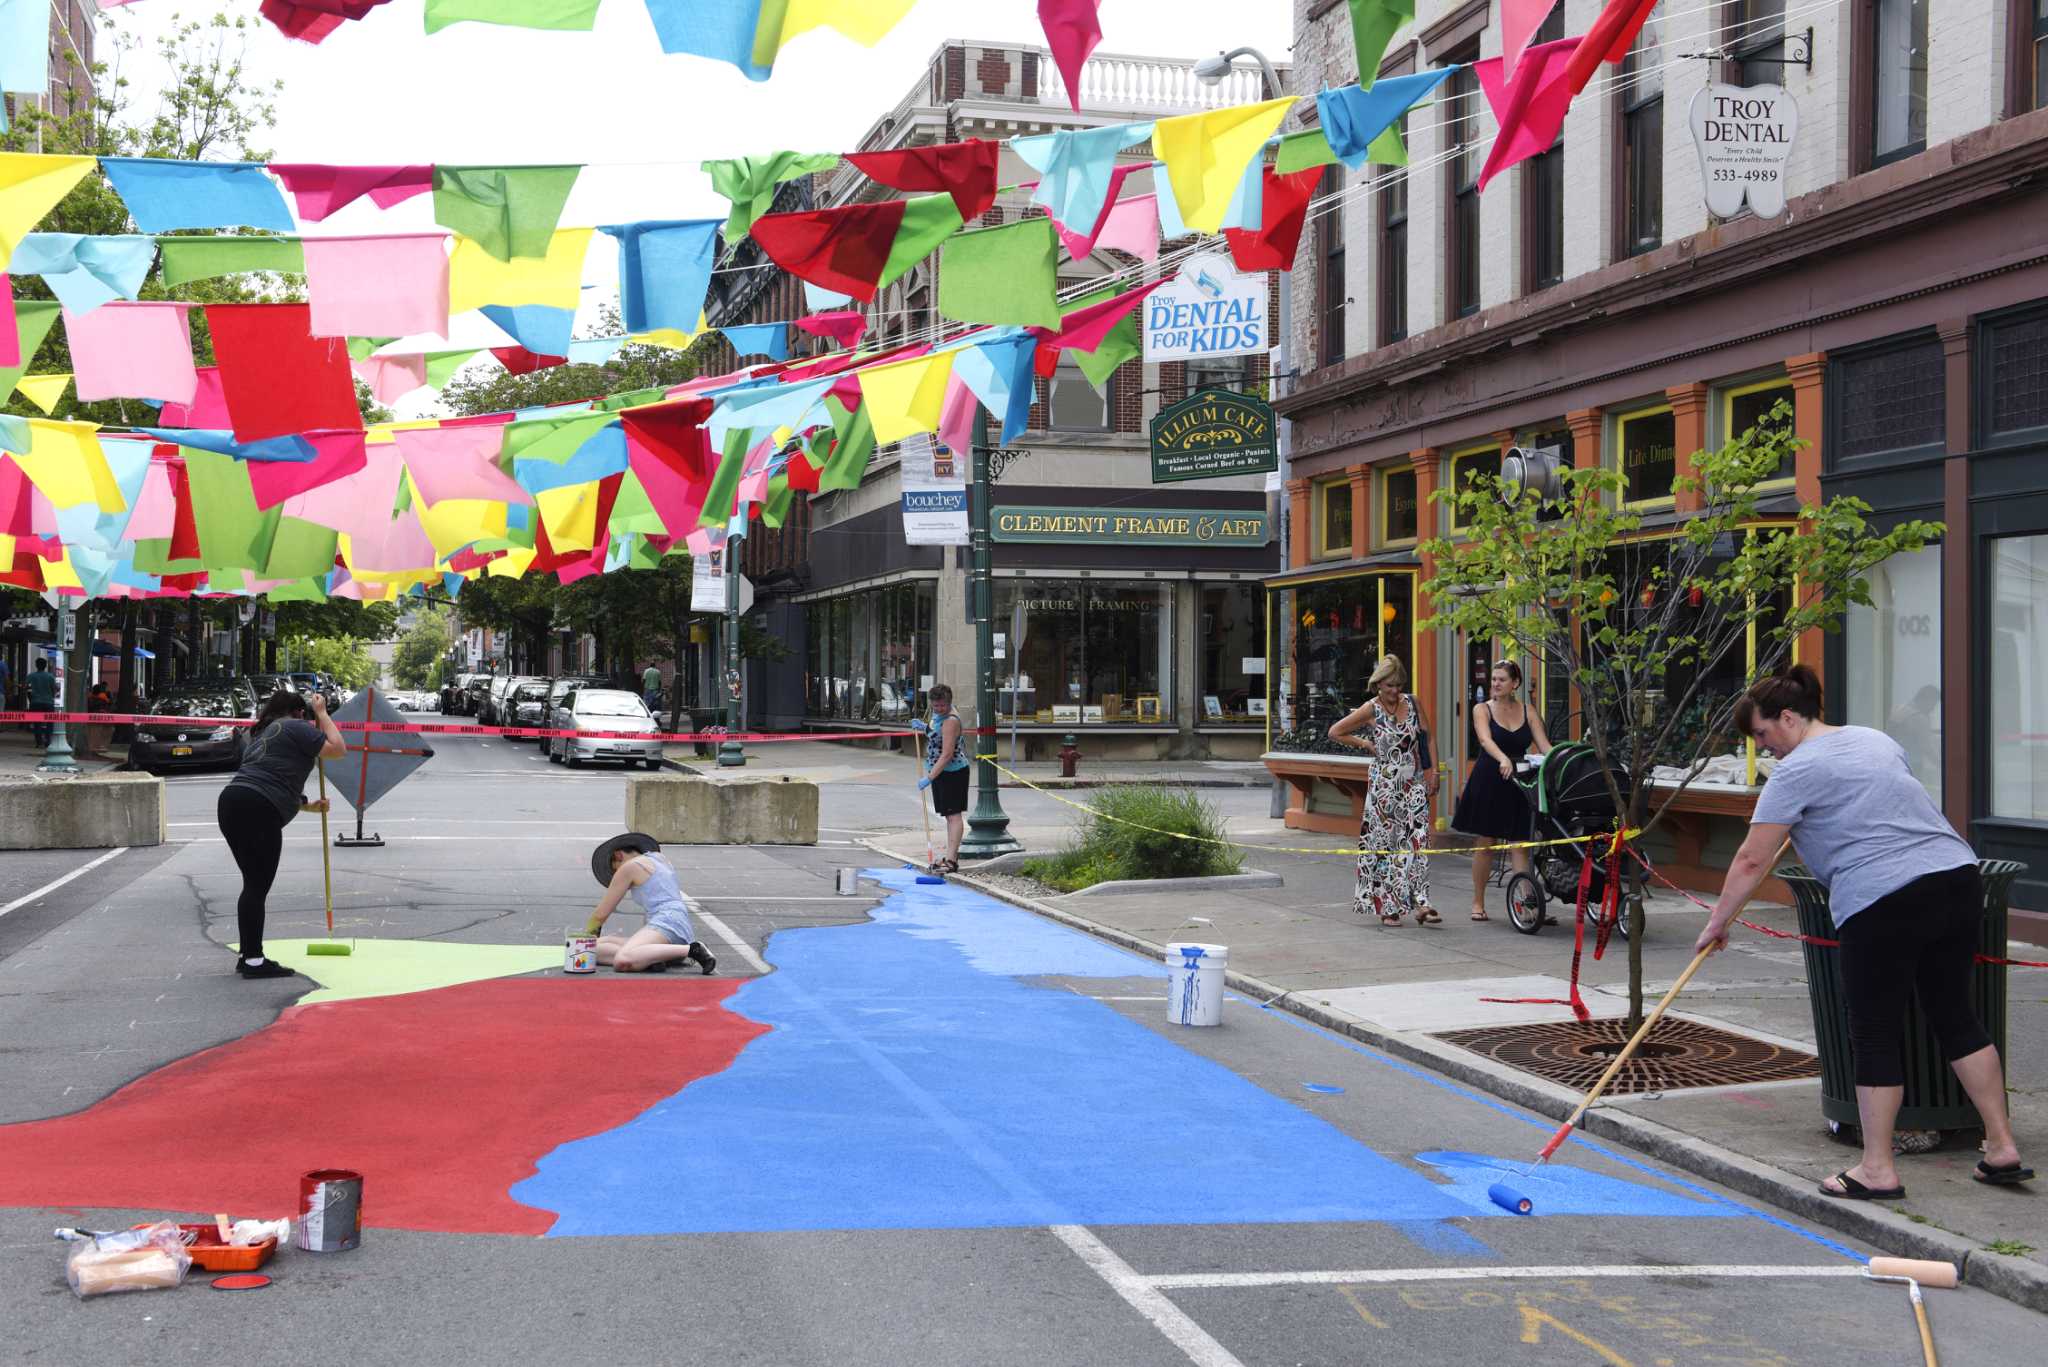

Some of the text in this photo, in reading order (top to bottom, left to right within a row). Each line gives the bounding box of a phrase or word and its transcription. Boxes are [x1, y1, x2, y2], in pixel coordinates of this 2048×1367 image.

[1714, 97, 1775, 120] TROY
[1704, 120, 1789, 142] DENTAL
[1713, 169, 1778, 181] 533-4989
[1150, 295, 1176, 310] Troy
[1149, 298, 1262, 331] DENTAL
[1152, 324, 1260, 353] FOR KIDS
[1157, 407, 1217, 449] ILLIUM
[1158, 457, 1189, 466] Breakfast
[1213, 452, 1240, 461] Organic
[1169, 465, 1194, 473] Famous
[1195, 462, 1219, 470] Corned
[1220, 459, 1236, 467] Beef
[905, 493, 962, 508] bouchey
[1000, 515, 1263, 541] CLEMENT FRAME & ART
[1088, 601, 1150, 611] FRAMING
